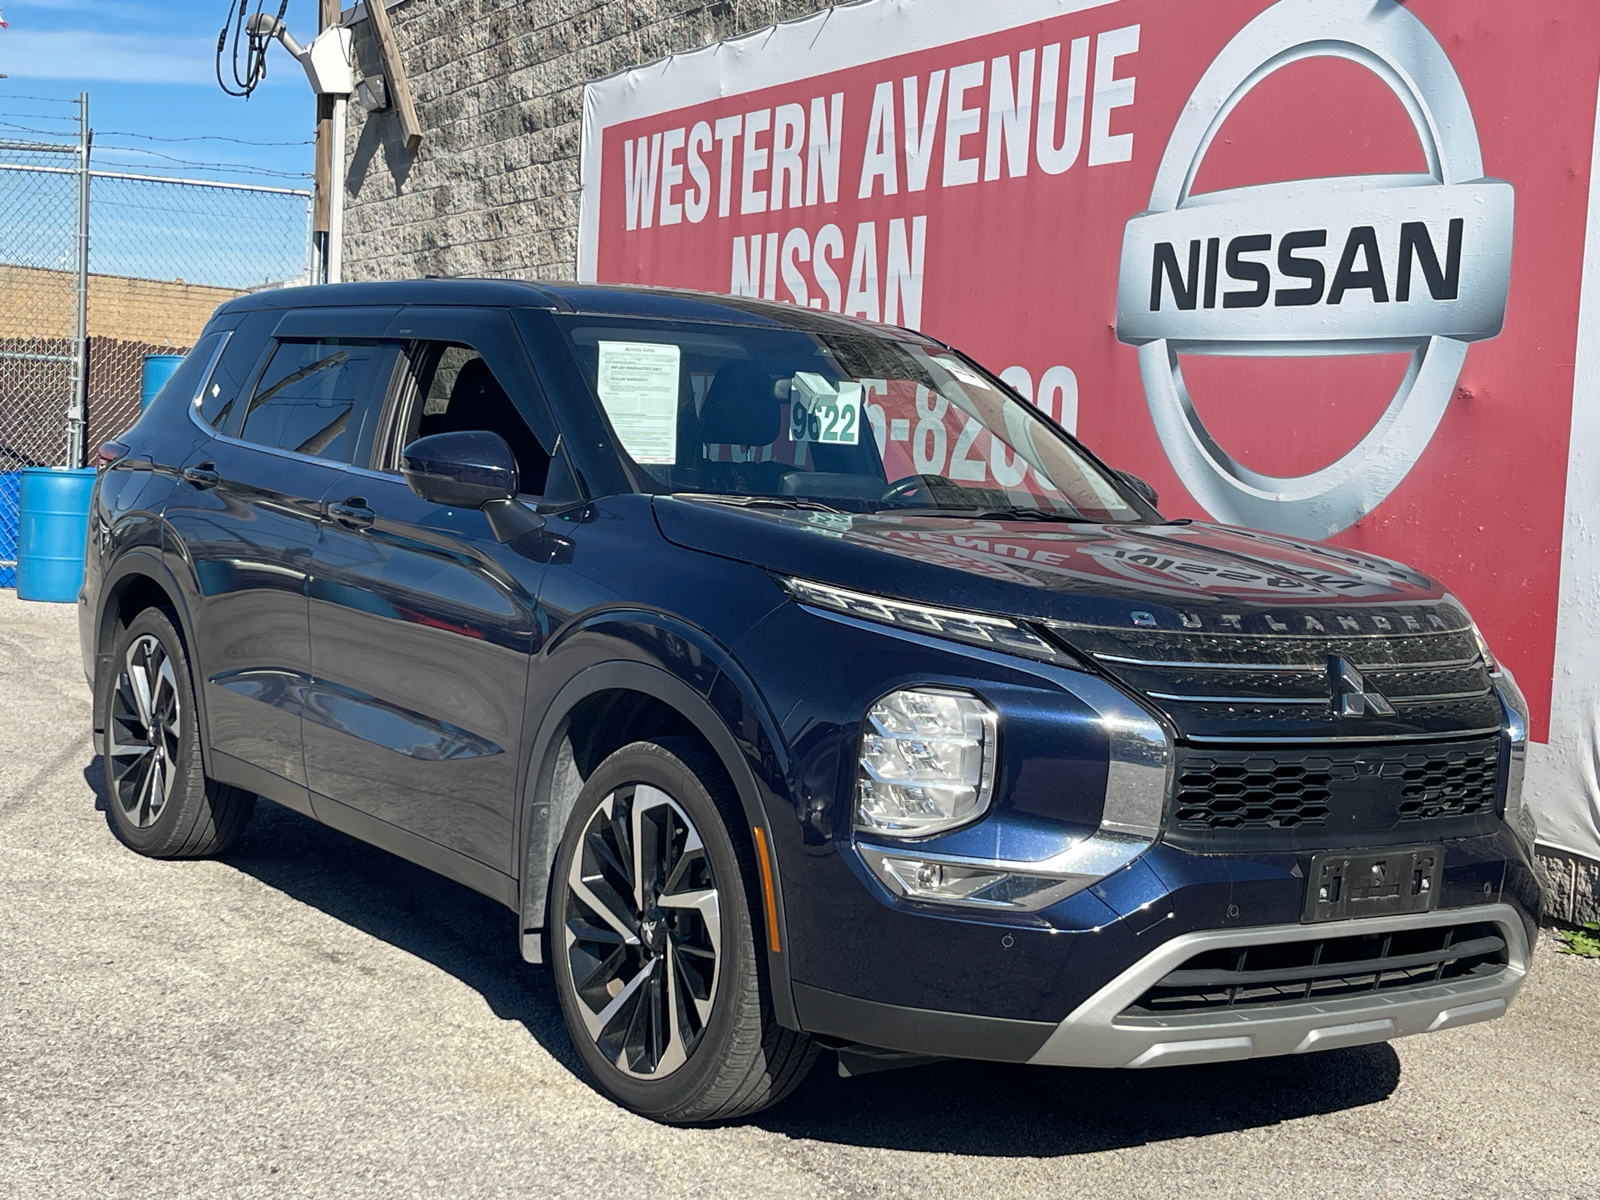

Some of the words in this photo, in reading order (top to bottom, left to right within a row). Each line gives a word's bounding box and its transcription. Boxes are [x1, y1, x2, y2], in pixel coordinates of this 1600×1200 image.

[624, 93, 844, 231] WESTERN
[858, 24, 1141, 199] AVENUE
[730, 215, 927, 330] NISSAN
[1149, 217, 1464, 312] NISSAN
[792, 401, 856, 442] 9622
[1129, 609, 1449, 633] OUTLANDER
